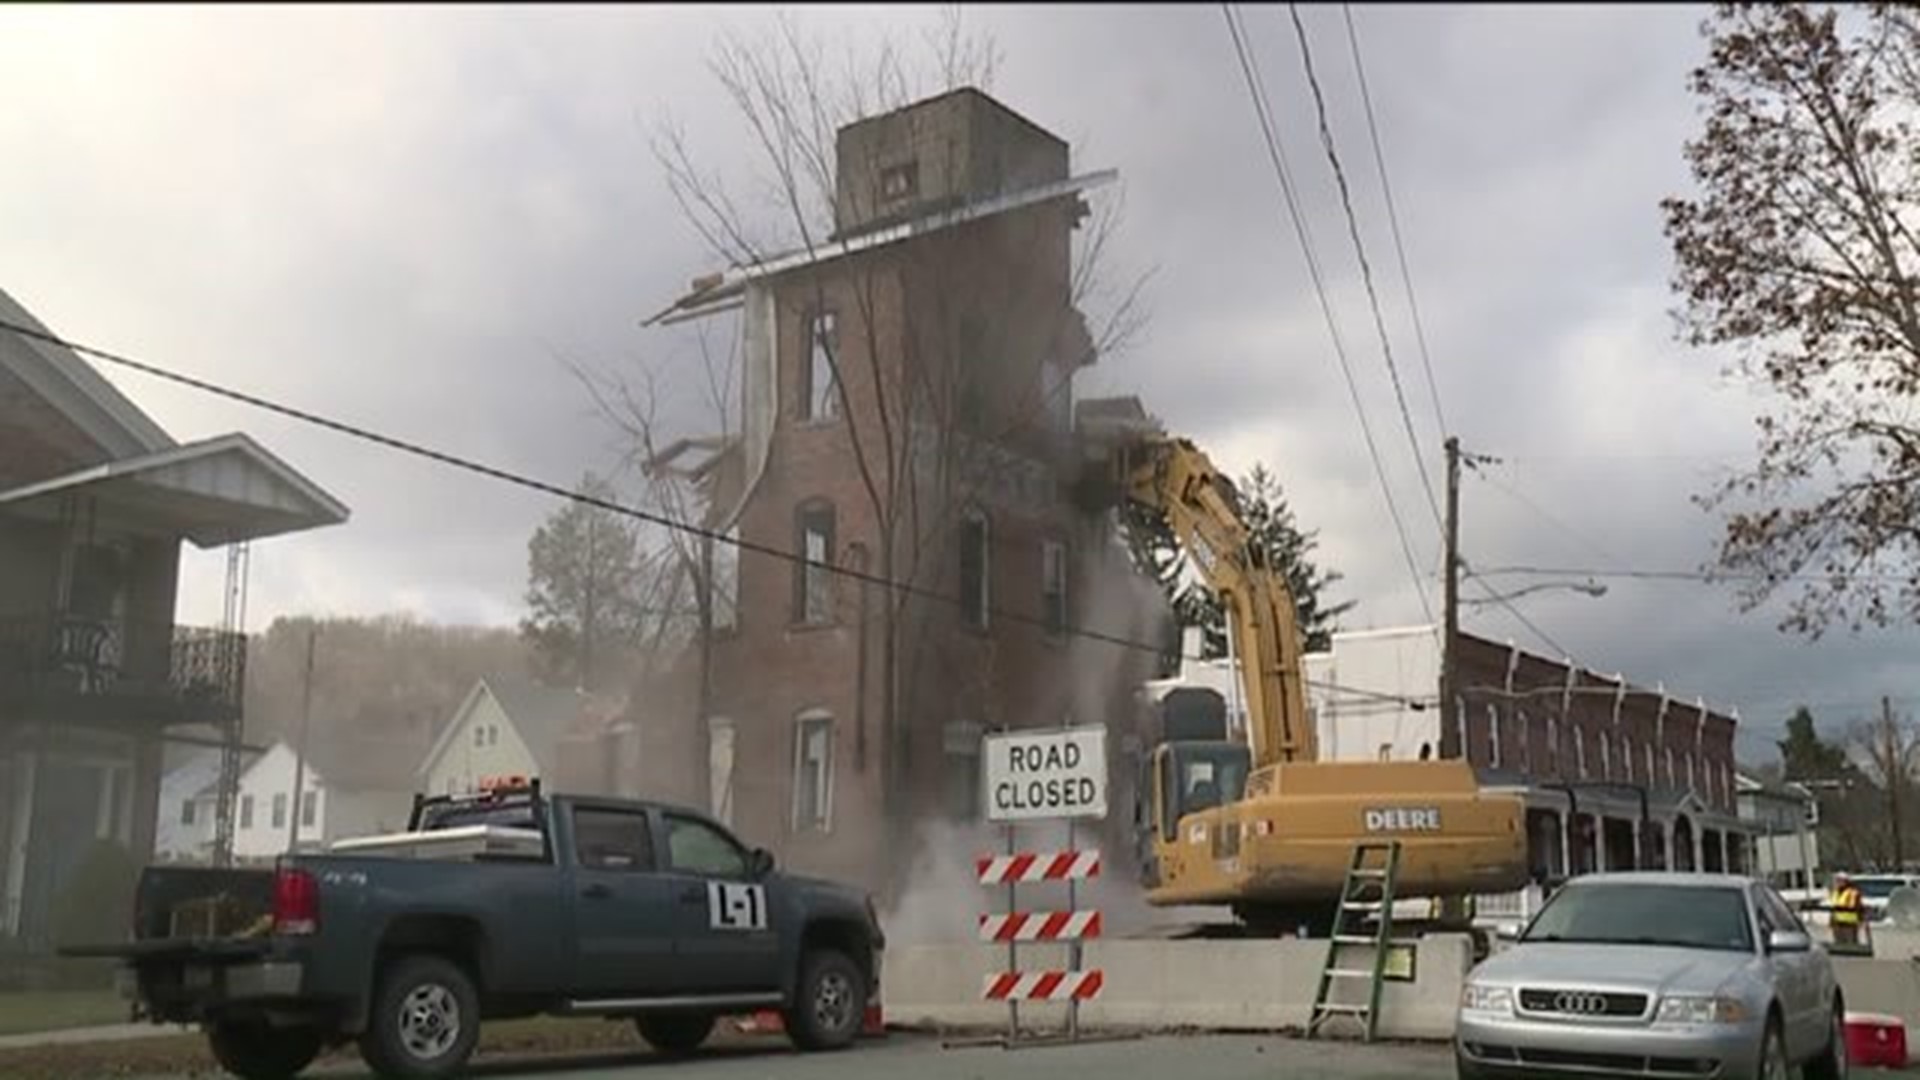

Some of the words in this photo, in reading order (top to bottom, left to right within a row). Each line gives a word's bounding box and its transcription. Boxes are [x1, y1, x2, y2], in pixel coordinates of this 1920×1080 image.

[1009, 742, 1081, 772] ROAD
[995, 777, 1095, 809] CLOSED
[1365, 808, 1441, 831] DEERE
[718, 884, 758, 927] L-1
